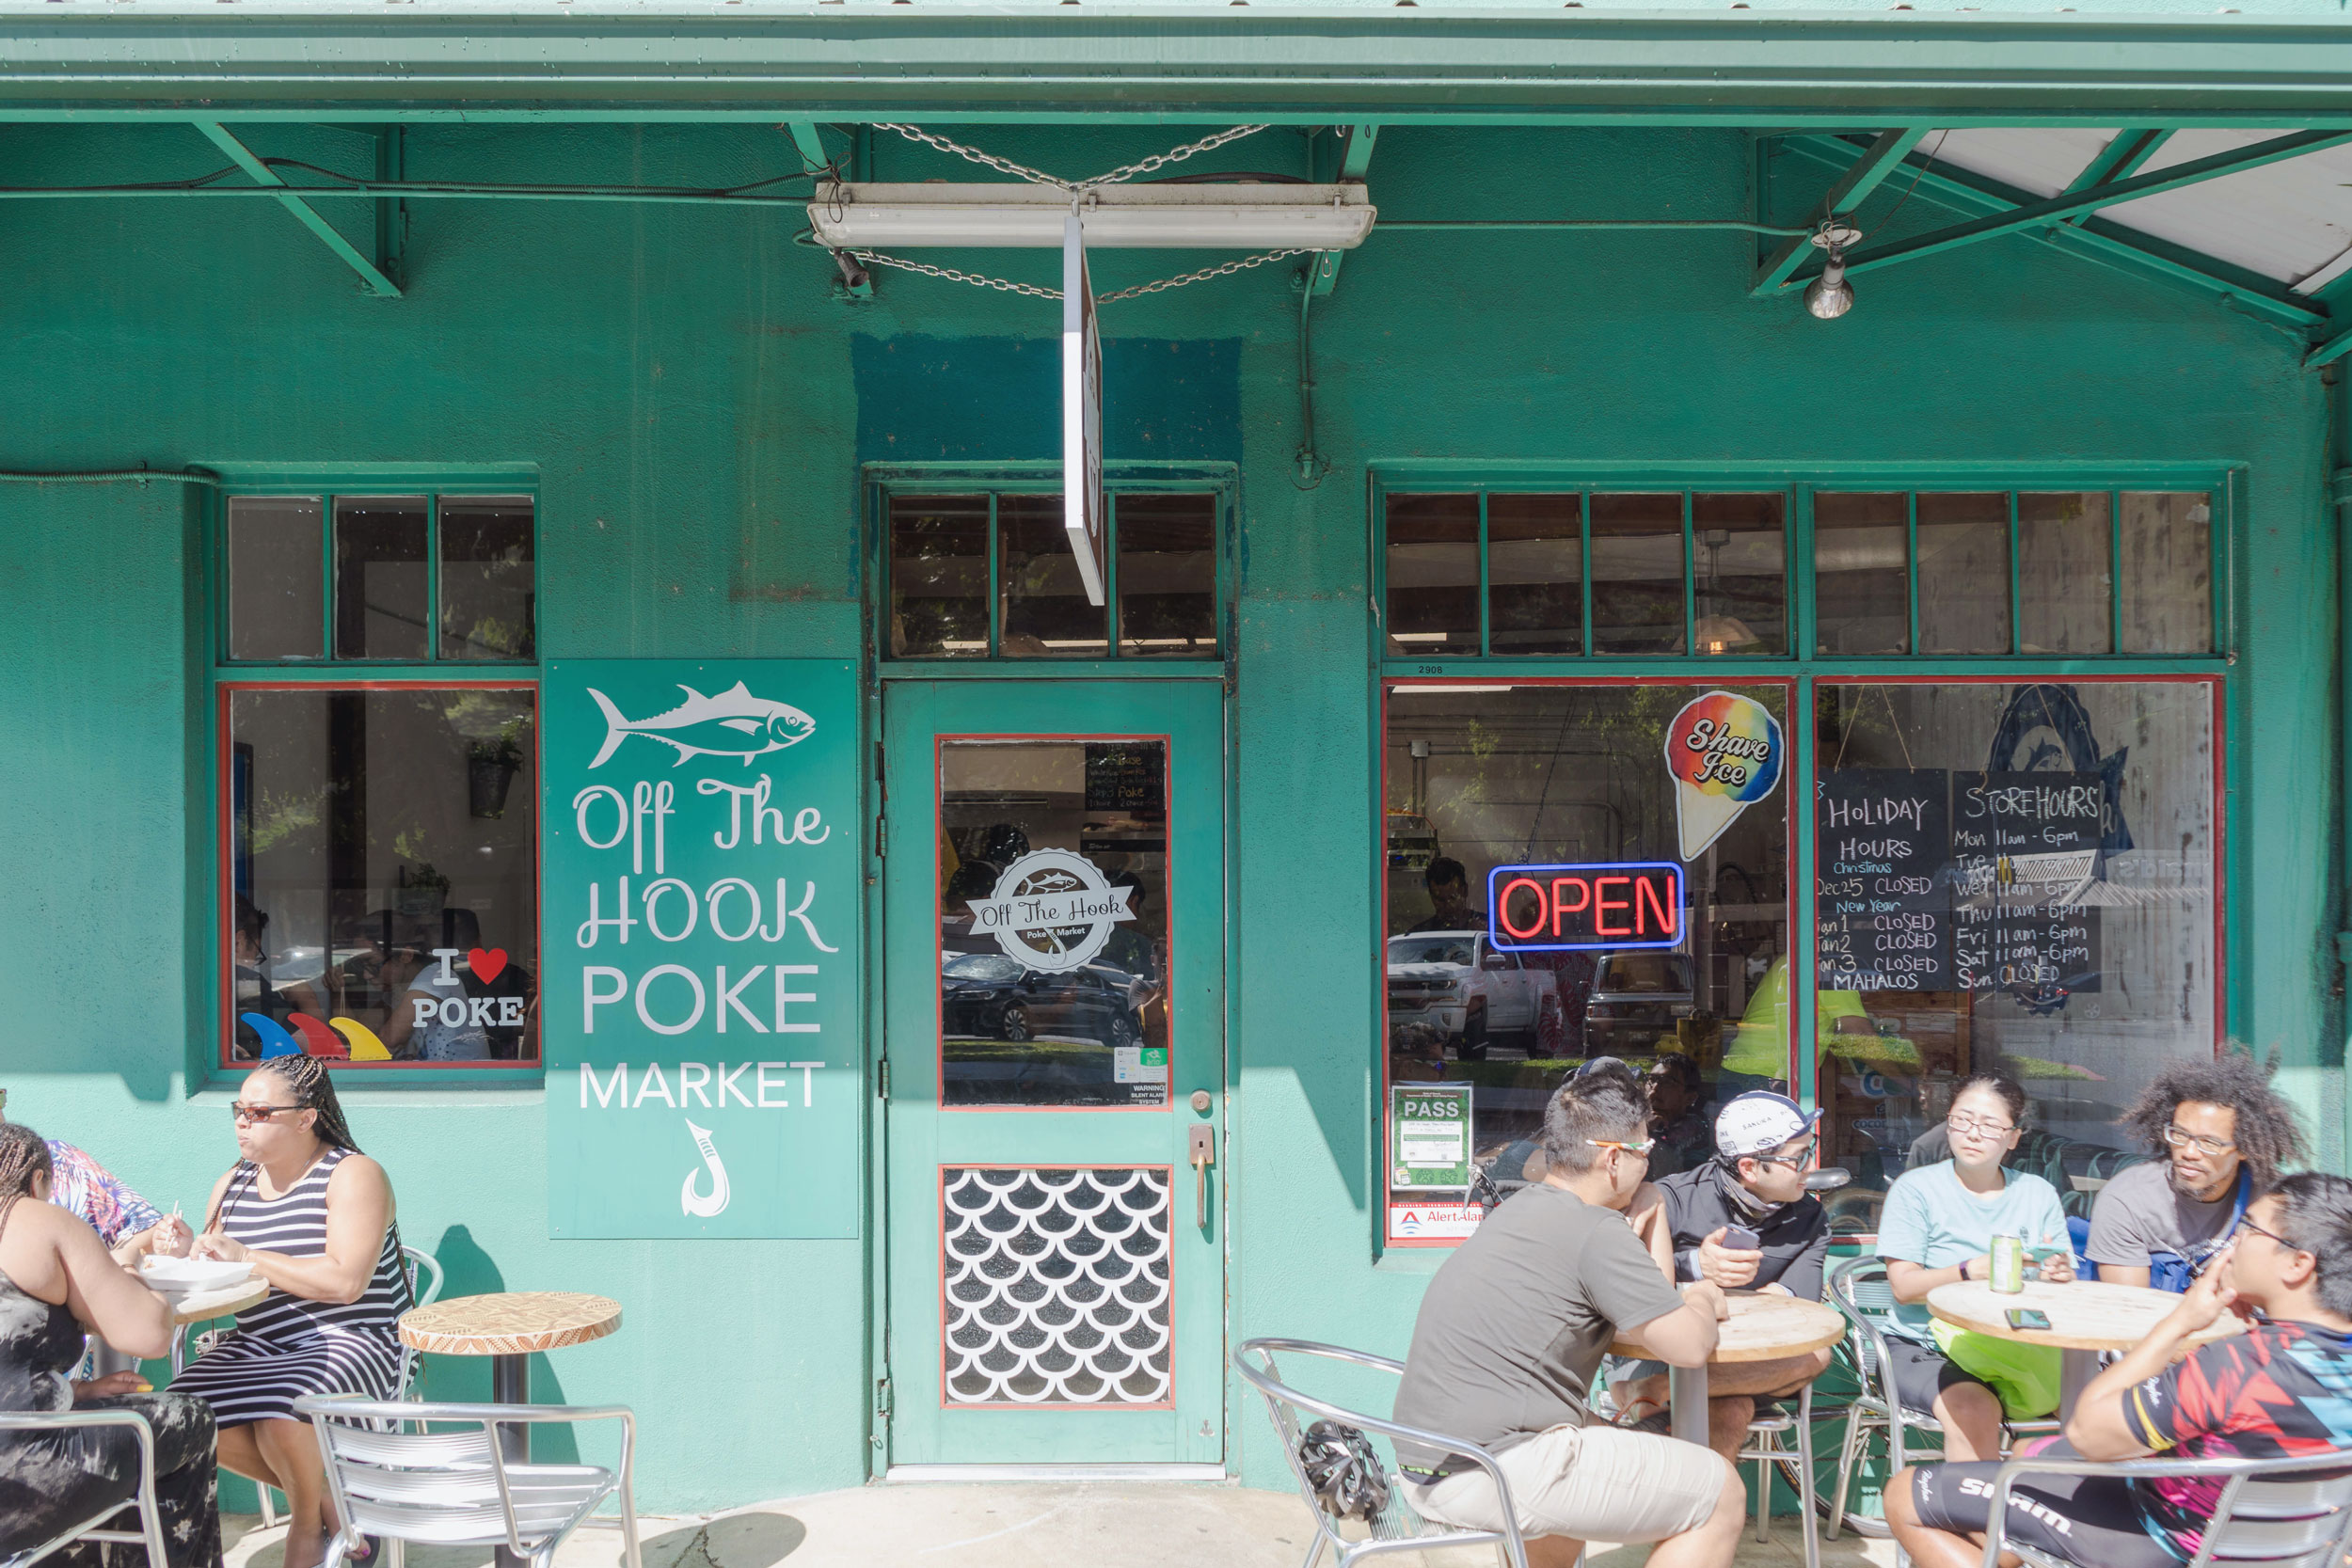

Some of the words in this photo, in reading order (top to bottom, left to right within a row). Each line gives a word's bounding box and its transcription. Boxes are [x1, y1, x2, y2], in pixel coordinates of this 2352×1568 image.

[1418, 665, 1443, 674] 2908
[1686, 719, 1770, 763] Shave
[1693, 752, 1746, 786] Ice
[1118, 784, 1144, 799] Poke
[572, 780, 675, 875] Off
[696, 773, 831, 849] The
[1828, 797, 1930, 832] HOLIDAY
[1954, 830, 1987, 847] Mon
[1995, 829, 2026, 846] 11am
[2042, 826, 2079, 847] 6pm
[1840, 837, 1913, 861] HOURS
[1834, 861, 1892, 875] Christmas
[1955, 853, 1987, 869] Tue
[1875, 876, 1932, 895] CLOSED
[577, 876, 839, 953] HOOK
[980, 904, 1013, 927] Off
[1018, 898, 1060, 924] The
[1068, 894, 1124, 921] Hook
[1499, 875, 1676, 939] OPEN
[1836, 900, 1866, 914] New
[1868, 898, 1901, 913] Year
[1955, 903, 1993, 925] Thu
[2048, 898, 2087, 922] 6pm
[1026, 928, 1047, 939] Poke
[1057, 927, 1086, 937] Market
[1874, 912, 1936, 932] CLOSED
[1875, 930, 1938, 951] CLOSED
[1956, 926, 1989, 946] Fri
[2048, 924, 2088, 945] 6pm
[1874, 955, 1938, 973] CLOSED
[1955, 945, 1990, 967] Sat
[2048, 942, 2089, 964] 6pm
[432, 948, 460, 986] I
[1834, 973, 1919, 990] MAHALOS
[582, 963, 821, 1035] POKE
[412, 997, 524, 1028] POKE
[580, 1061, 826, 1108] MARKET
[1405, 1101, 1459, 1117] PASS
[1427, 1211, 1456, 1222] Alert
